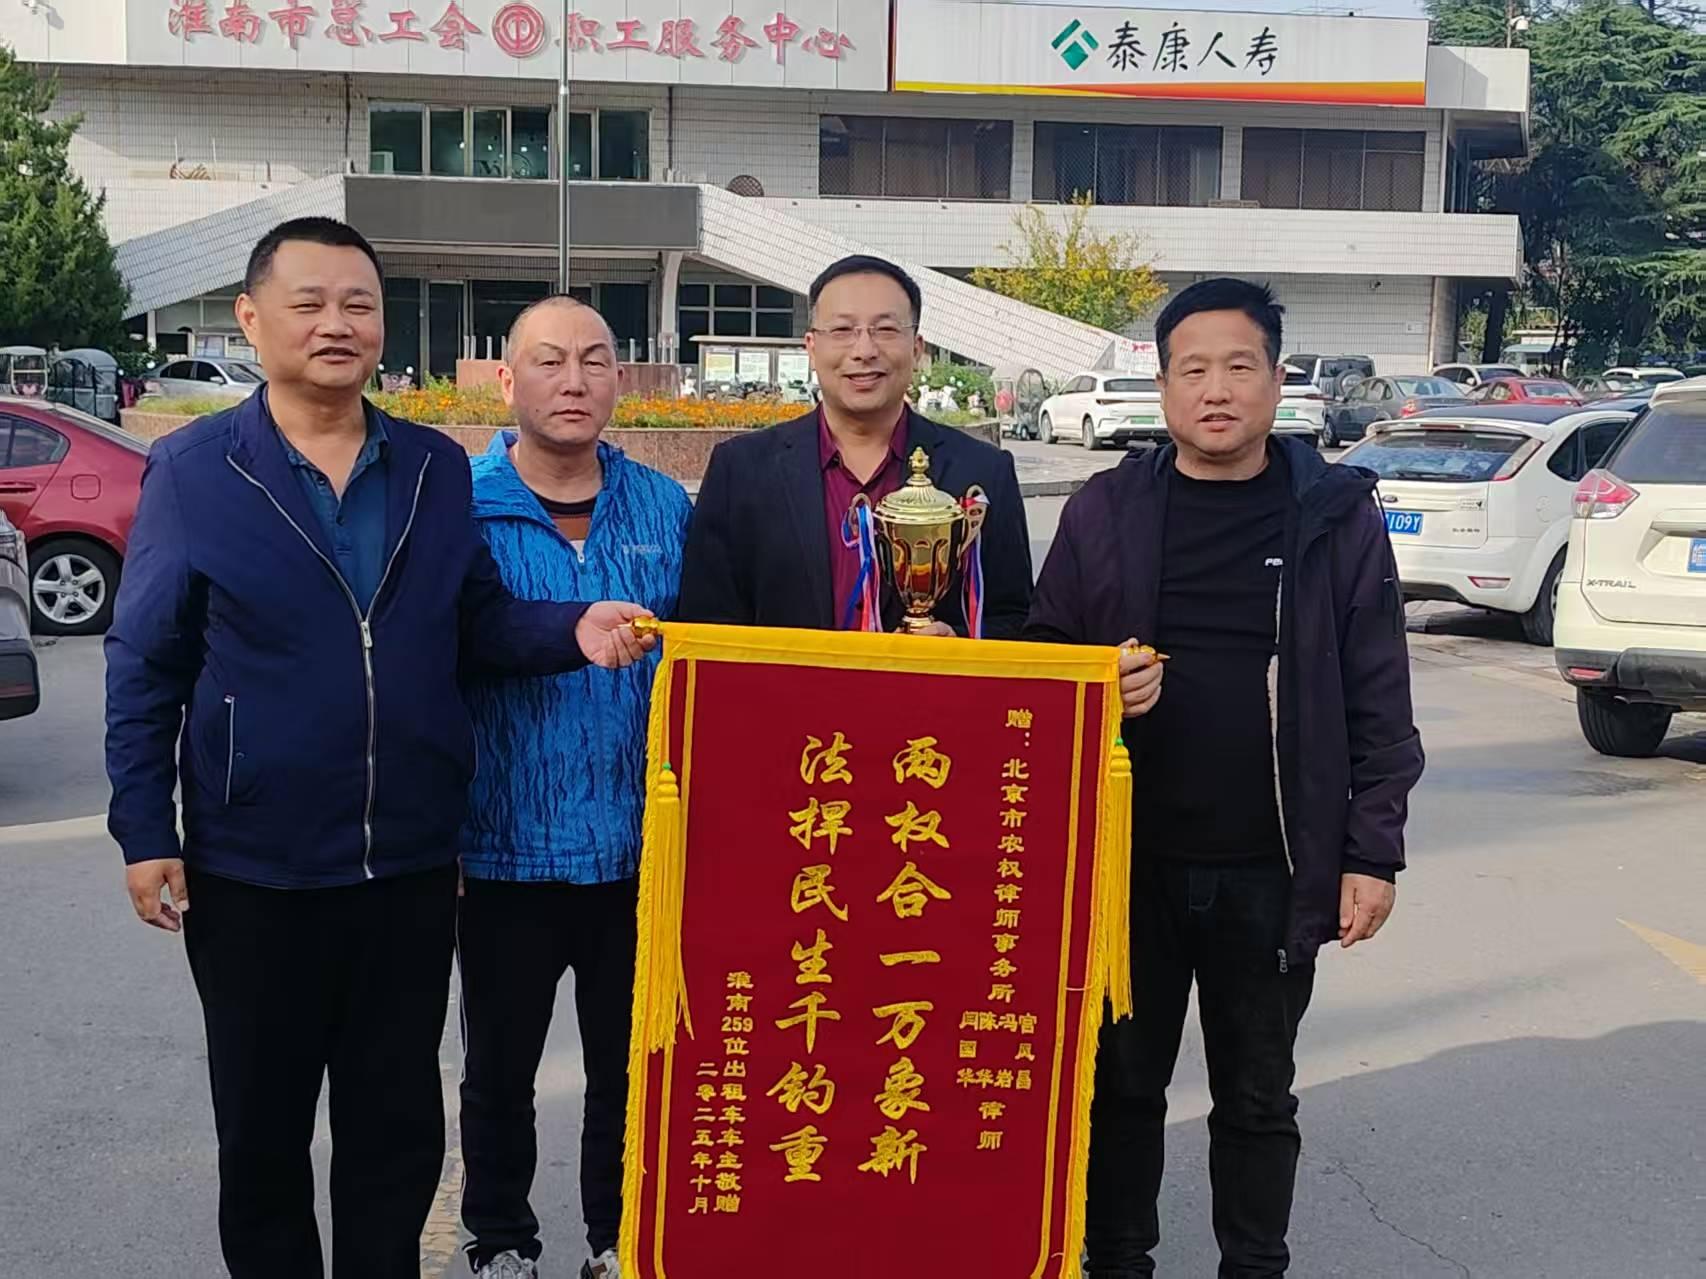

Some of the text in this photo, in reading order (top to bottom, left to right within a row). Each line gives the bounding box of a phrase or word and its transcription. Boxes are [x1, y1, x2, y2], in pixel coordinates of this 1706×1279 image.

[168, 0, 857, 65] 淮南市总工会 职工服务中心
[1105, 20, 1279, 76] 泰康人寿
[1586, 579, 1637, 589] X-TRAIL
[766, 732, 854, 1184] 法捍民生千钧重
[858, 736, 952, 1185] 两权合一万象新
[687, 1061, 719, 1215] 二零二五年十月
[976, 1101, 1006, 1151] 律师
